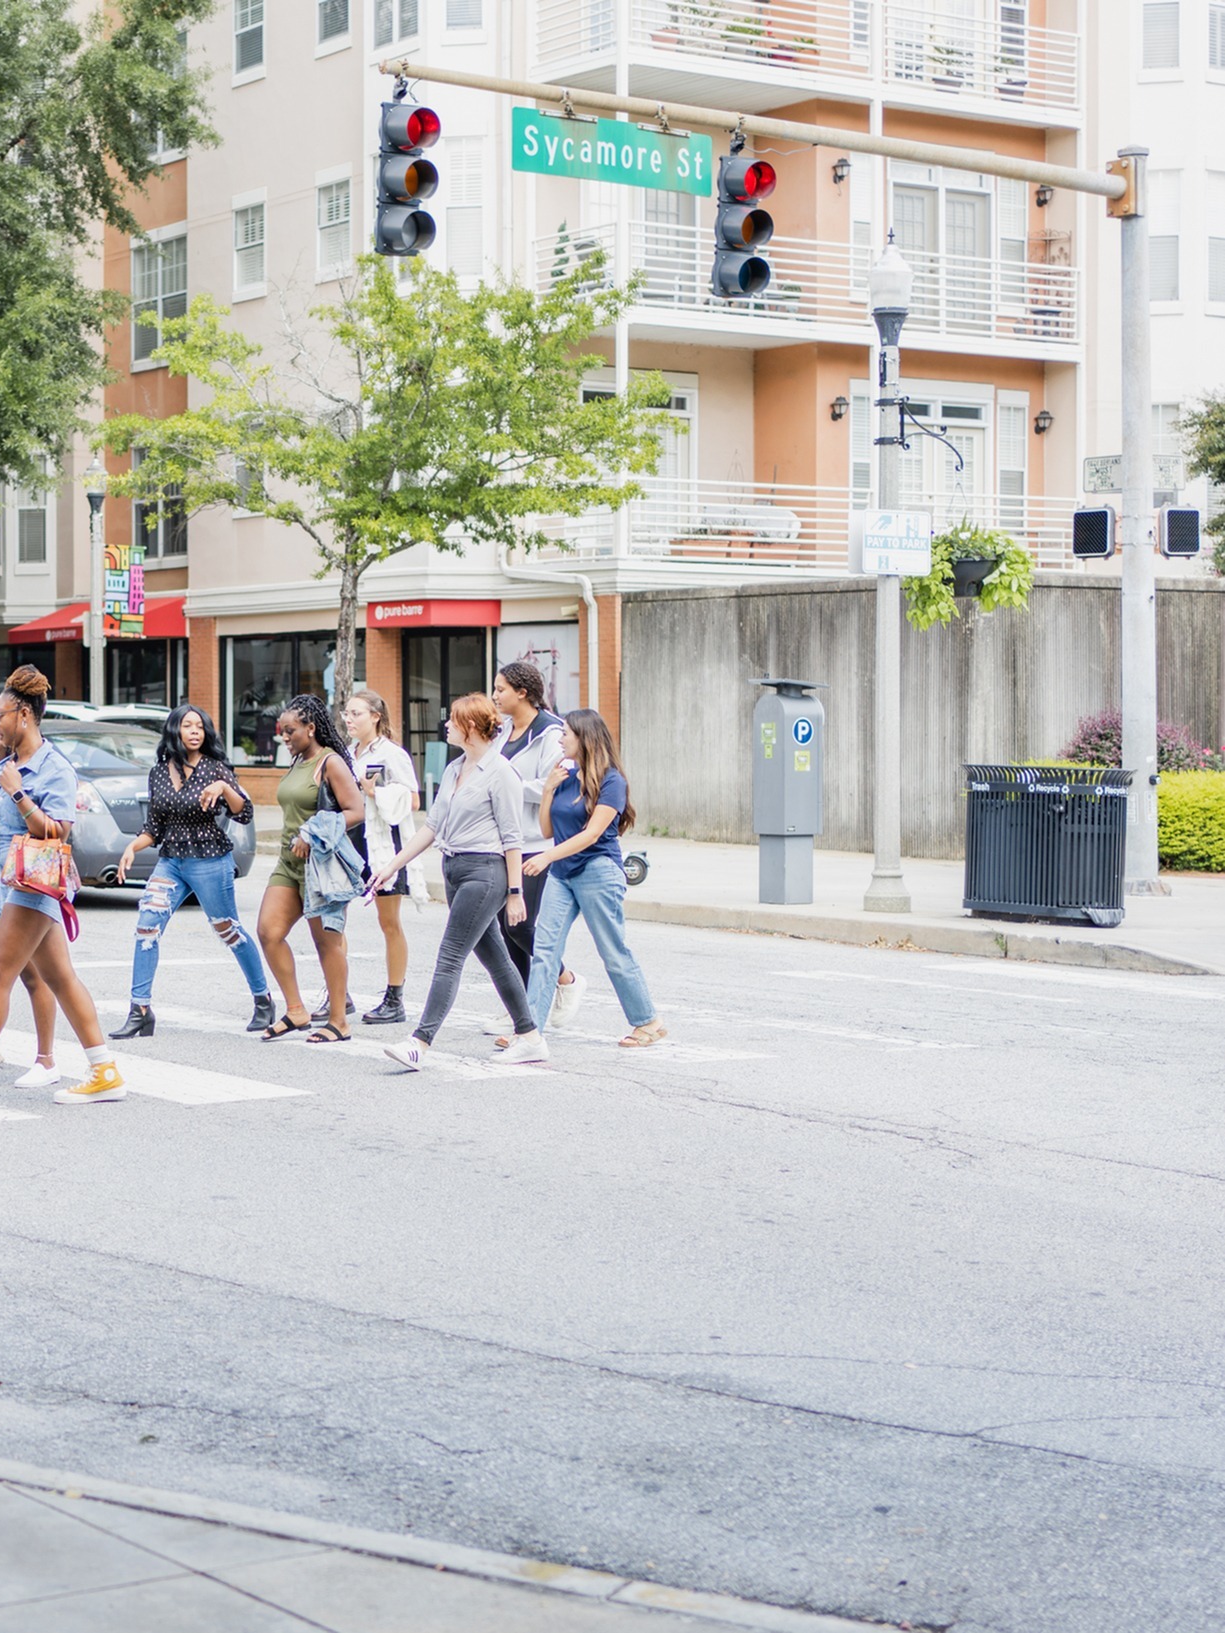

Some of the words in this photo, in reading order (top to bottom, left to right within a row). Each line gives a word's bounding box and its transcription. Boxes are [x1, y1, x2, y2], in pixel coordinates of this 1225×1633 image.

[523, 124, 662, 174] Sycamore
[677, 147, 704, 180] St
[867, 536, 884, 547] PAY
[887, 538, 899, 548] TO
[902, 538, 928, 549] PARK
[384, 606, 401, 619] pure
[402, 603, 424, 616] barre
[797, 721, 810, 741] P
[972, 782, 990, 791] Trash
[1036, 784, 1060, 793] Recycle
